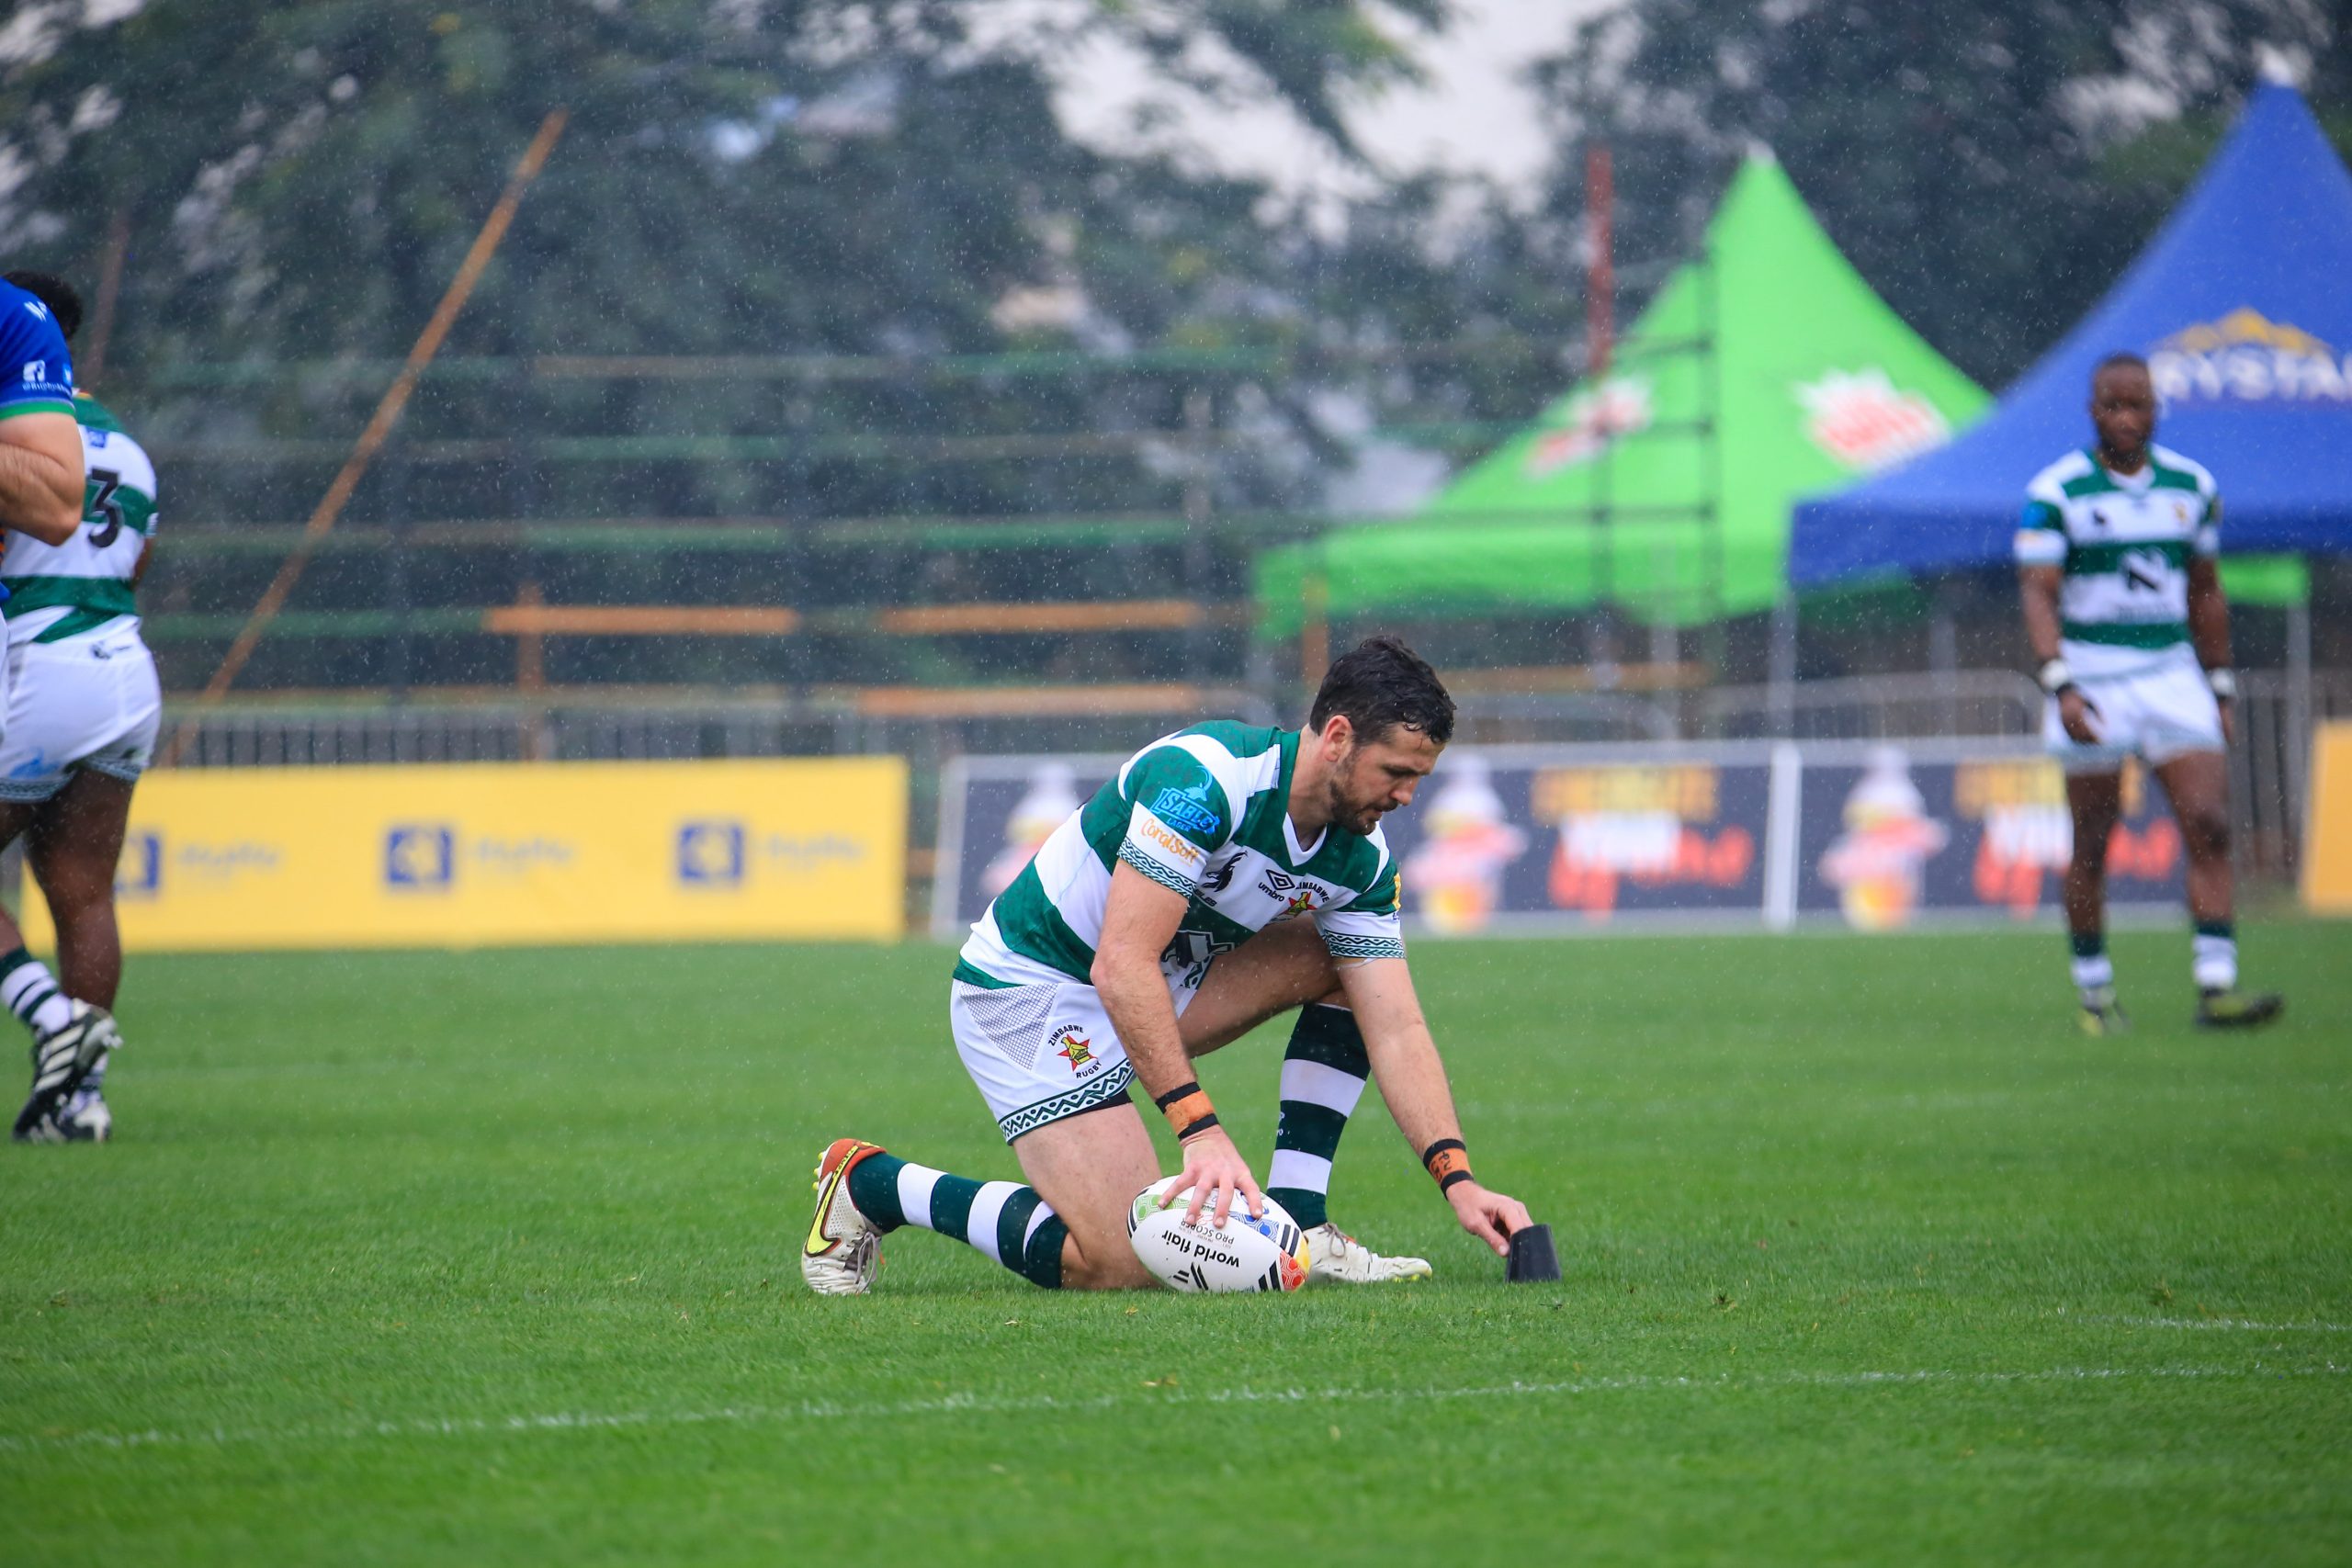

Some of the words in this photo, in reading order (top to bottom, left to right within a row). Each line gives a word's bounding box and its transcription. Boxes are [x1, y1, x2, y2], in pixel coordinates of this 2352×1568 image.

[2143, 345, 2352, 401] RYSTA
[1160, 791, 1213, 829] SABLE
[1166, 818, 1193, 832] LAGER
[1140, 818, 1199, 863] CoralSoft
[1258, 882, 1285, 902] umbro
[1048, 1024, 1084, 1047] ZIMBABWE
[1076, 1060, 1102, 1079] RUGBY
[1161, 1230, 1192, 1254] flair
[1215, 1232, 1235, 1245] PRO
[1193, 1244, 1239, 1268] world
